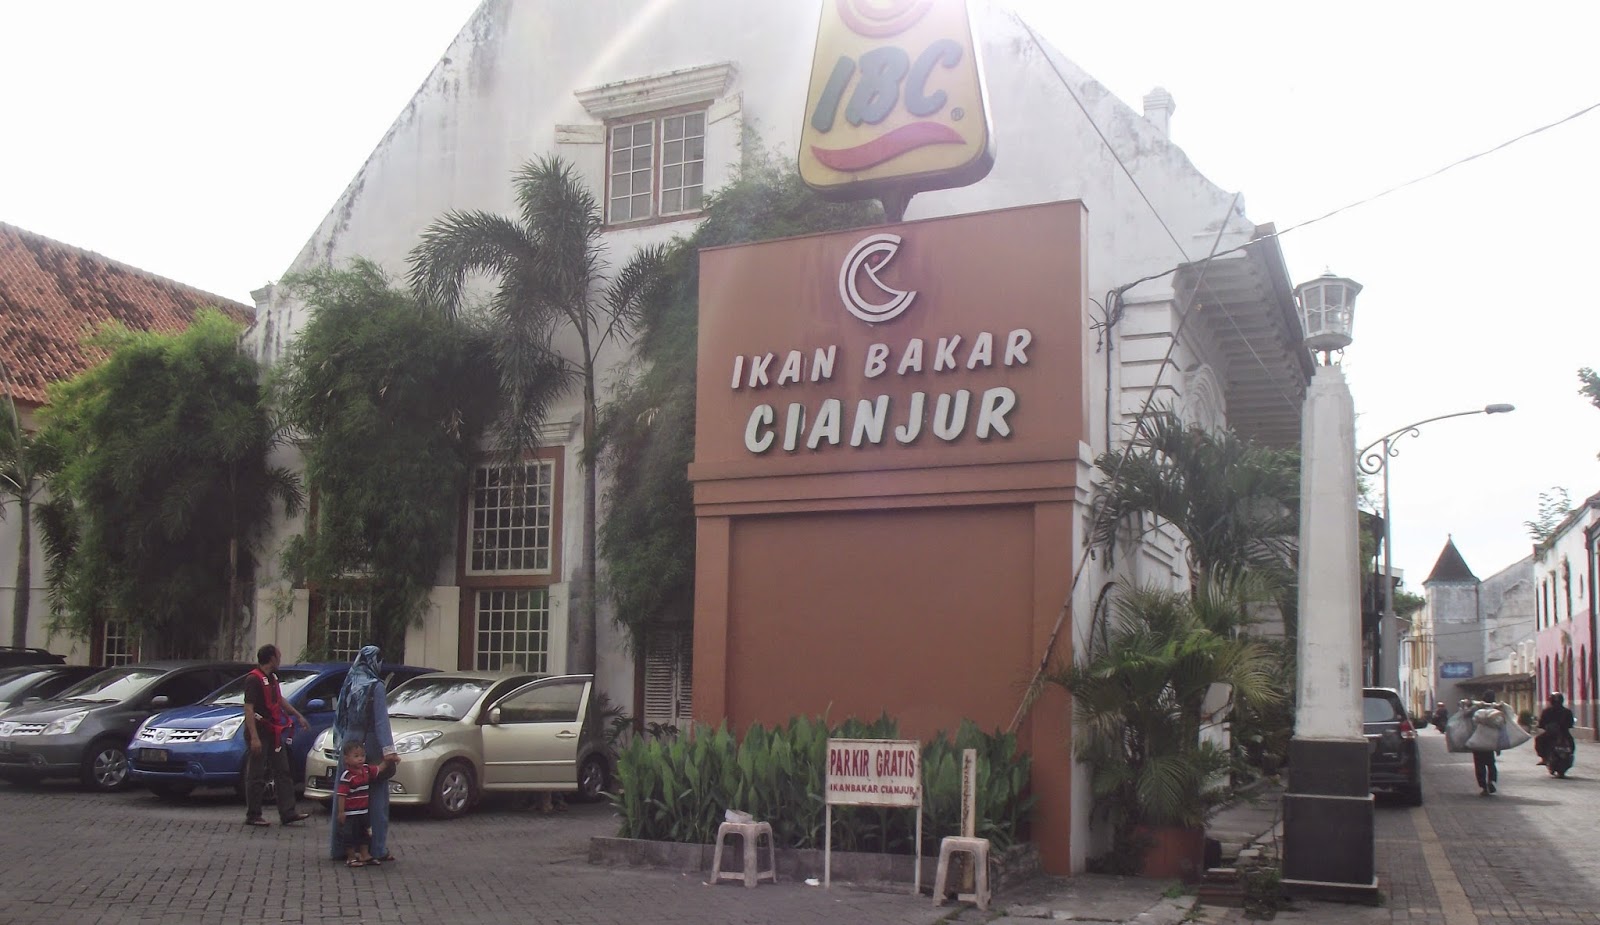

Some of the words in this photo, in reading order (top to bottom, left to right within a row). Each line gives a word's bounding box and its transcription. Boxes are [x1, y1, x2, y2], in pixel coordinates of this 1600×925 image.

[731, 345, 837, 389] IKAN
[864, 329, 1032, 378] BAKAR
[745, 387, 1016, 453] CIANJUR
[830, 749, 869, 776] PARKIR
[876, 749, 915, 778] GRATIS
